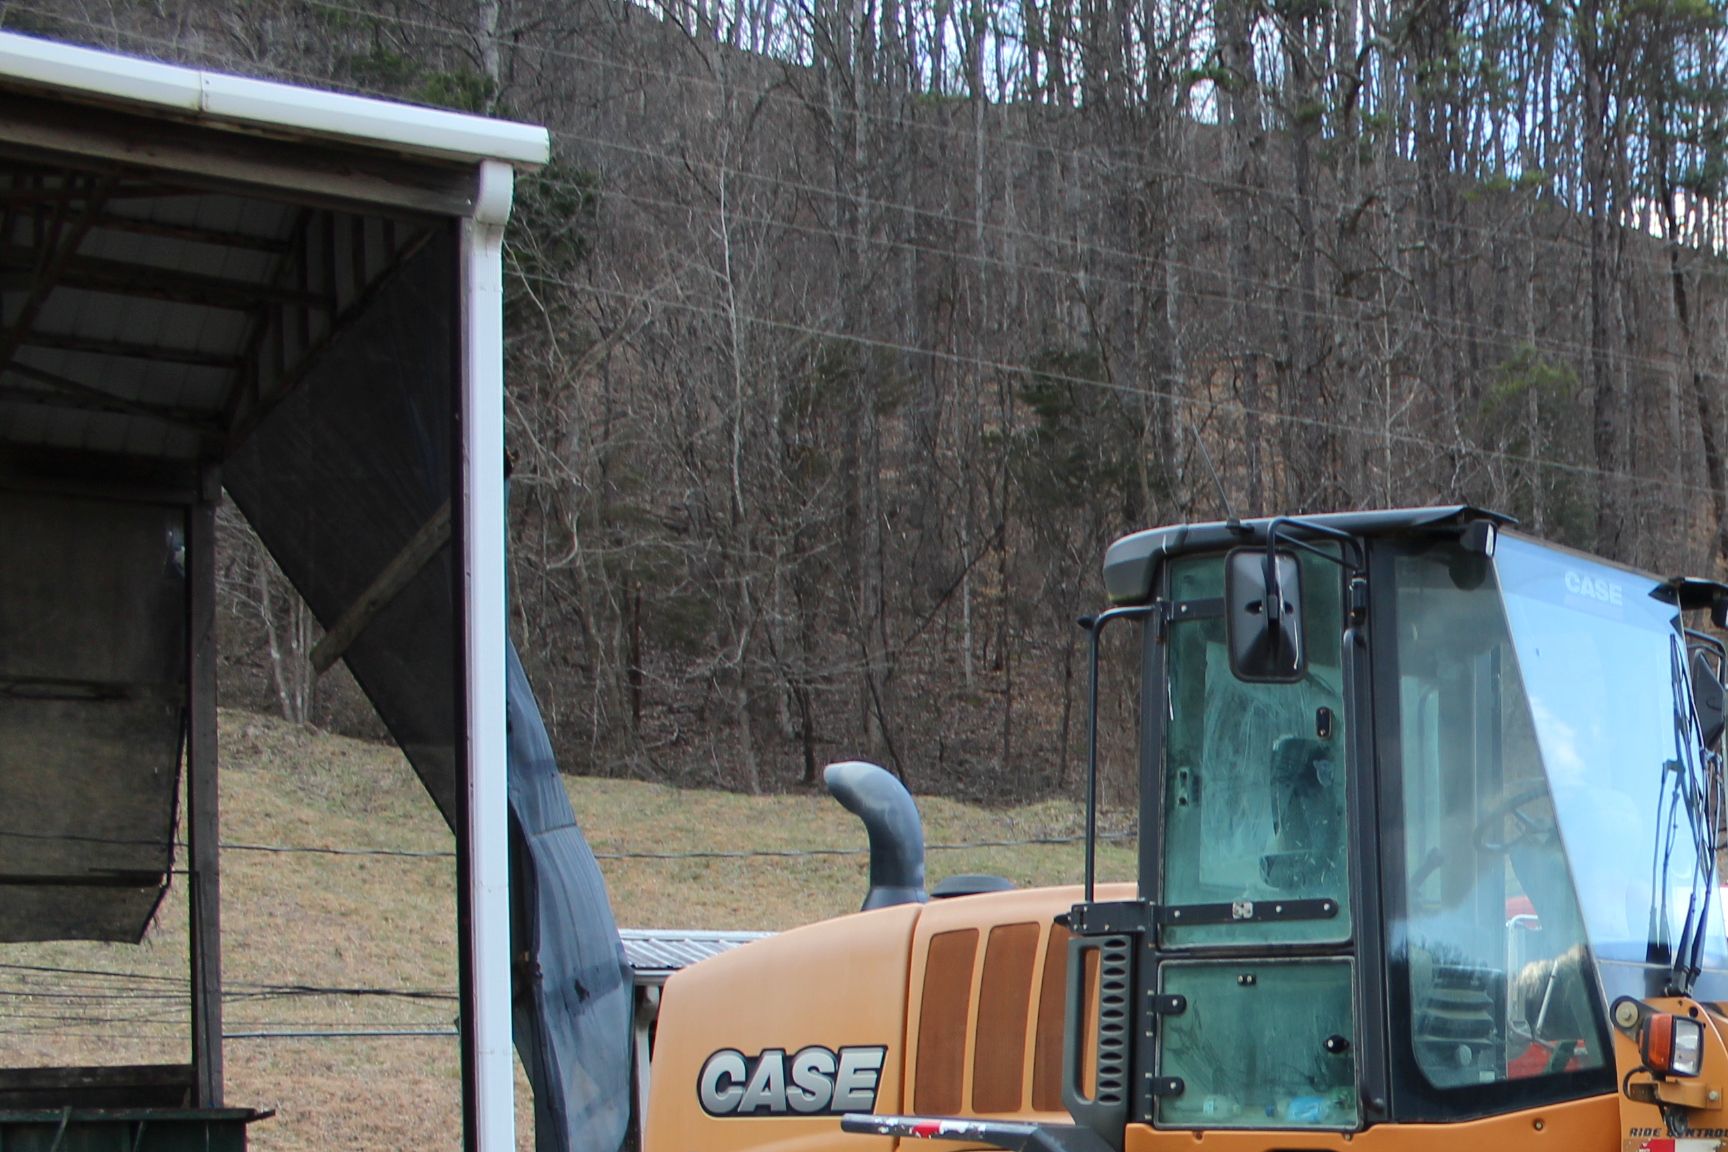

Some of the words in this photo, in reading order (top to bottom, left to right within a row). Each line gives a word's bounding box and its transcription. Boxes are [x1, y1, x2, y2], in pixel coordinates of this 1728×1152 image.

[1564, 570, 1623, 606] CASE
[700, 1046, 884, 1113] CASE
[1629, 1127, 1662, 1138] RIDE
